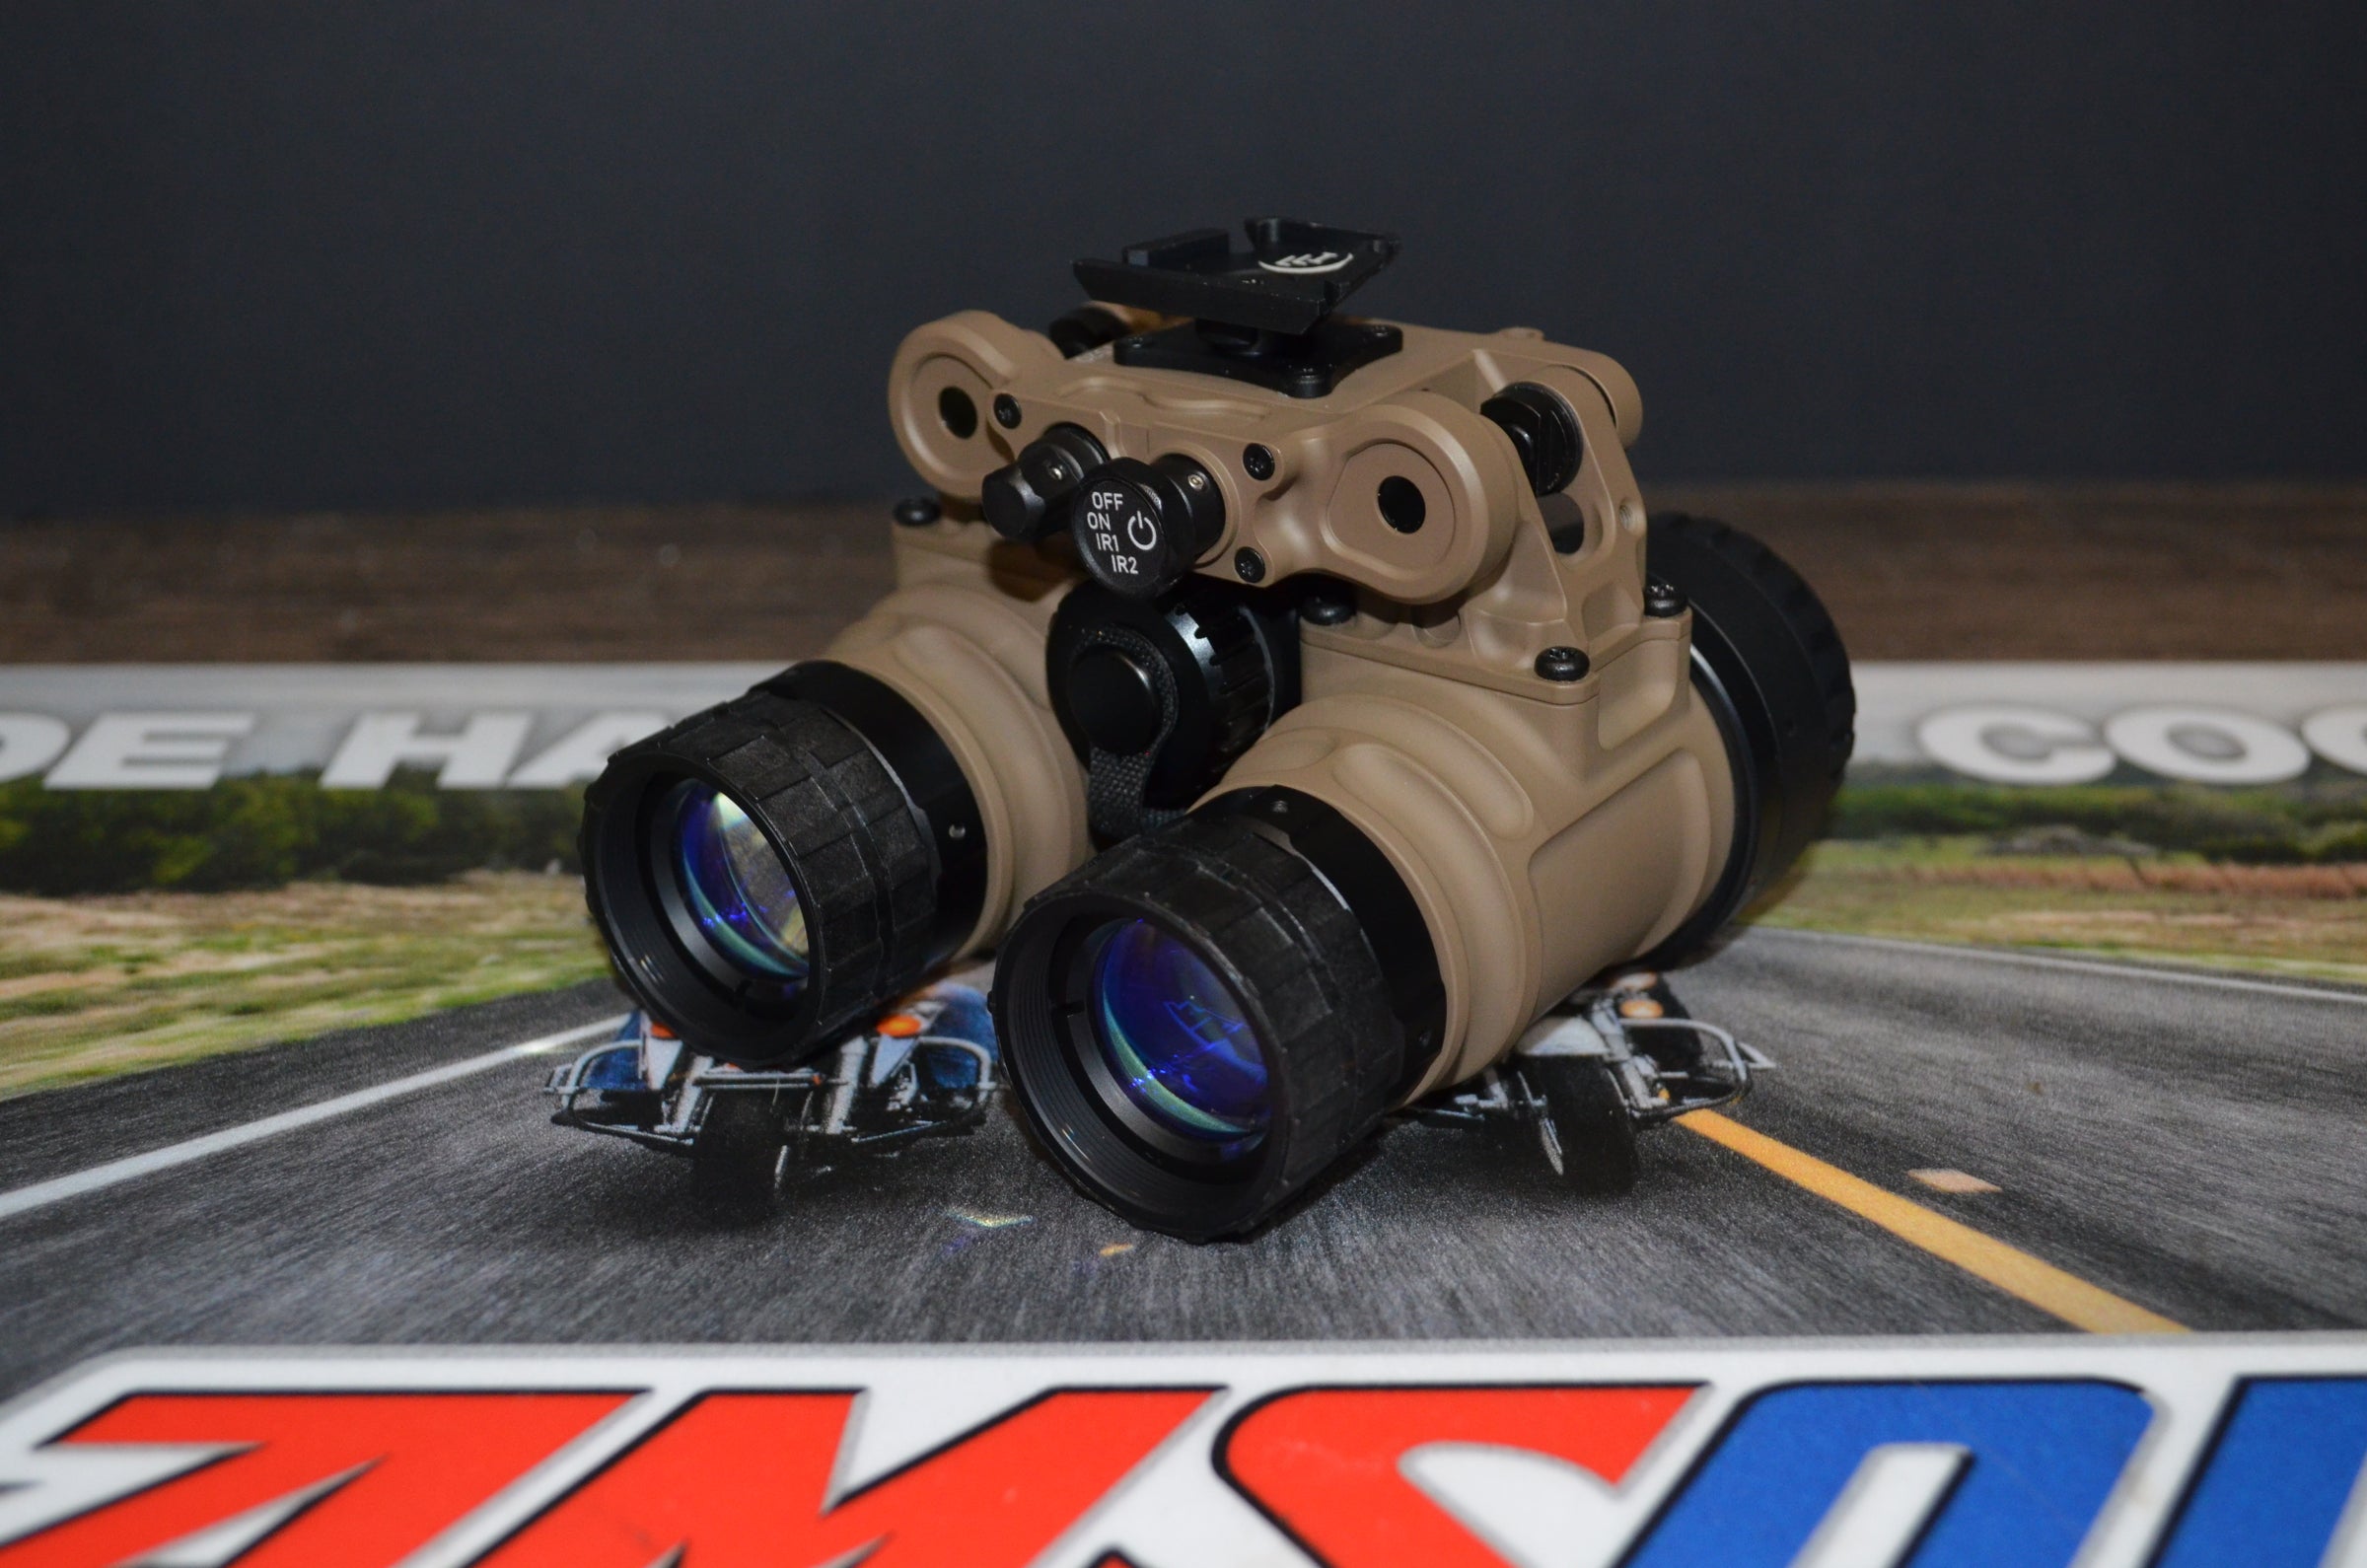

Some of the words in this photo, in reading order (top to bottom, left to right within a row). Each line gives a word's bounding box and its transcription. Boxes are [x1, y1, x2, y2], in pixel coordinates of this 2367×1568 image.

[1092, 491, 1123, 511] OFF
[1087, 511, 1112, 531] ON
[1096, 533, 1119, 552] IR1
[1111, 554, 1139, 574] IR2
